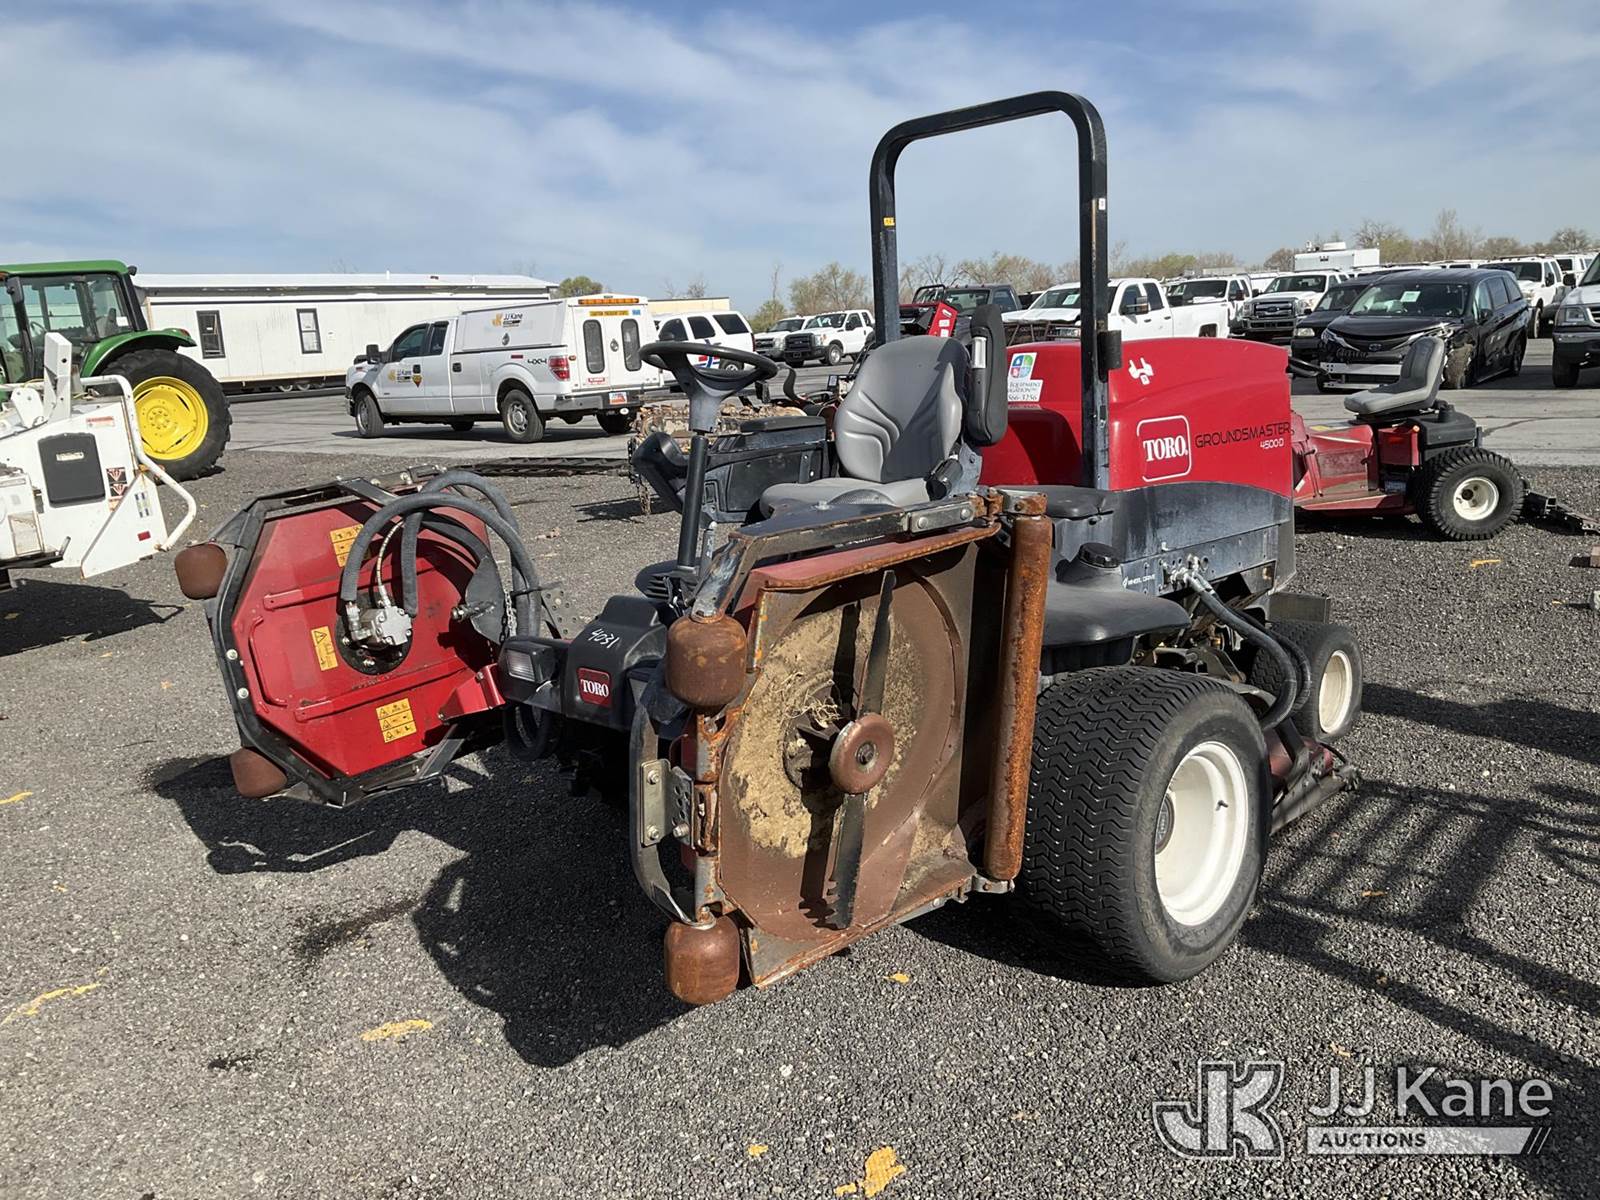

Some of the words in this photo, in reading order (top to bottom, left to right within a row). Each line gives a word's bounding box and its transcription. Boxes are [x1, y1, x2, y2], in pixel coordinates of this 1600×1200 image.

[1143, 435, 1188, 462] TORO
[588, 628, 620, 649] 4031
[580, 679, 610, 697] TORO
